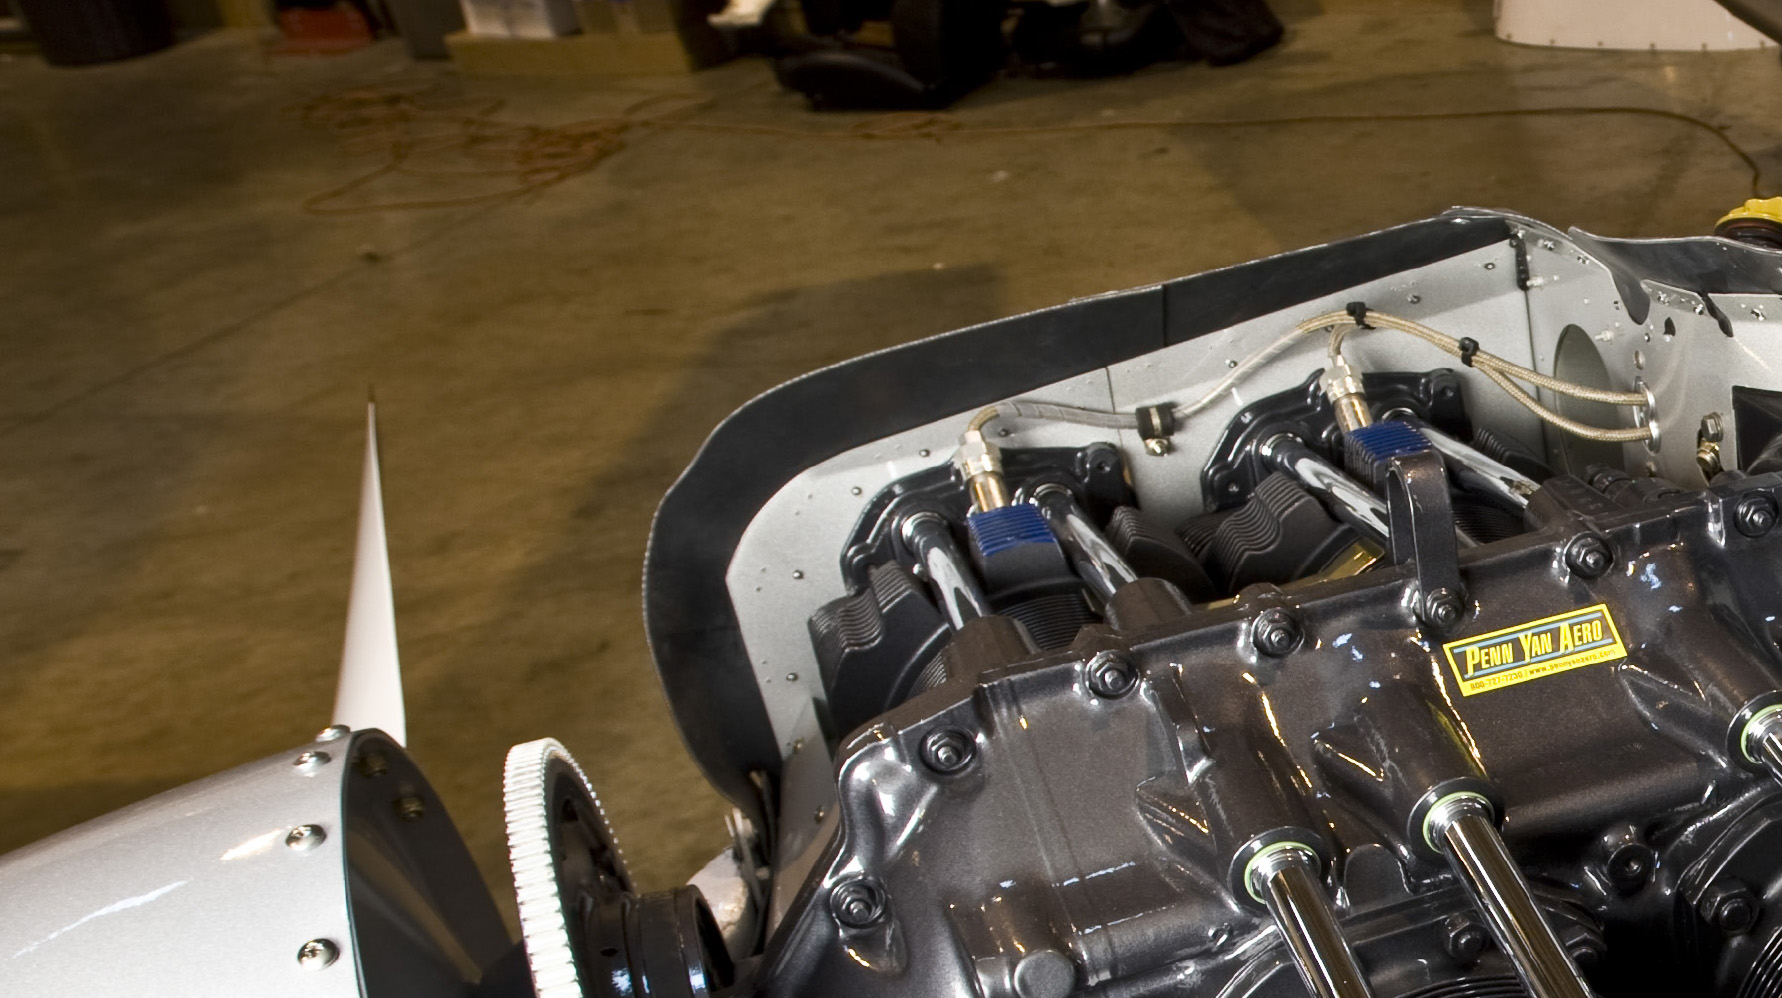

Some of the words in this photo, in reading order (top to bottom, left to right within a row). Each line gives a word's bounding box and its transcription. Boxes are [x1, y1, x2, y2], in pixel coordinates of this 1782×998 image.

[1466, 645, 1514, 678] PENN
[1517, 629, 1553, 664] YAN
[1558, 618, 1603, 655] AERO
